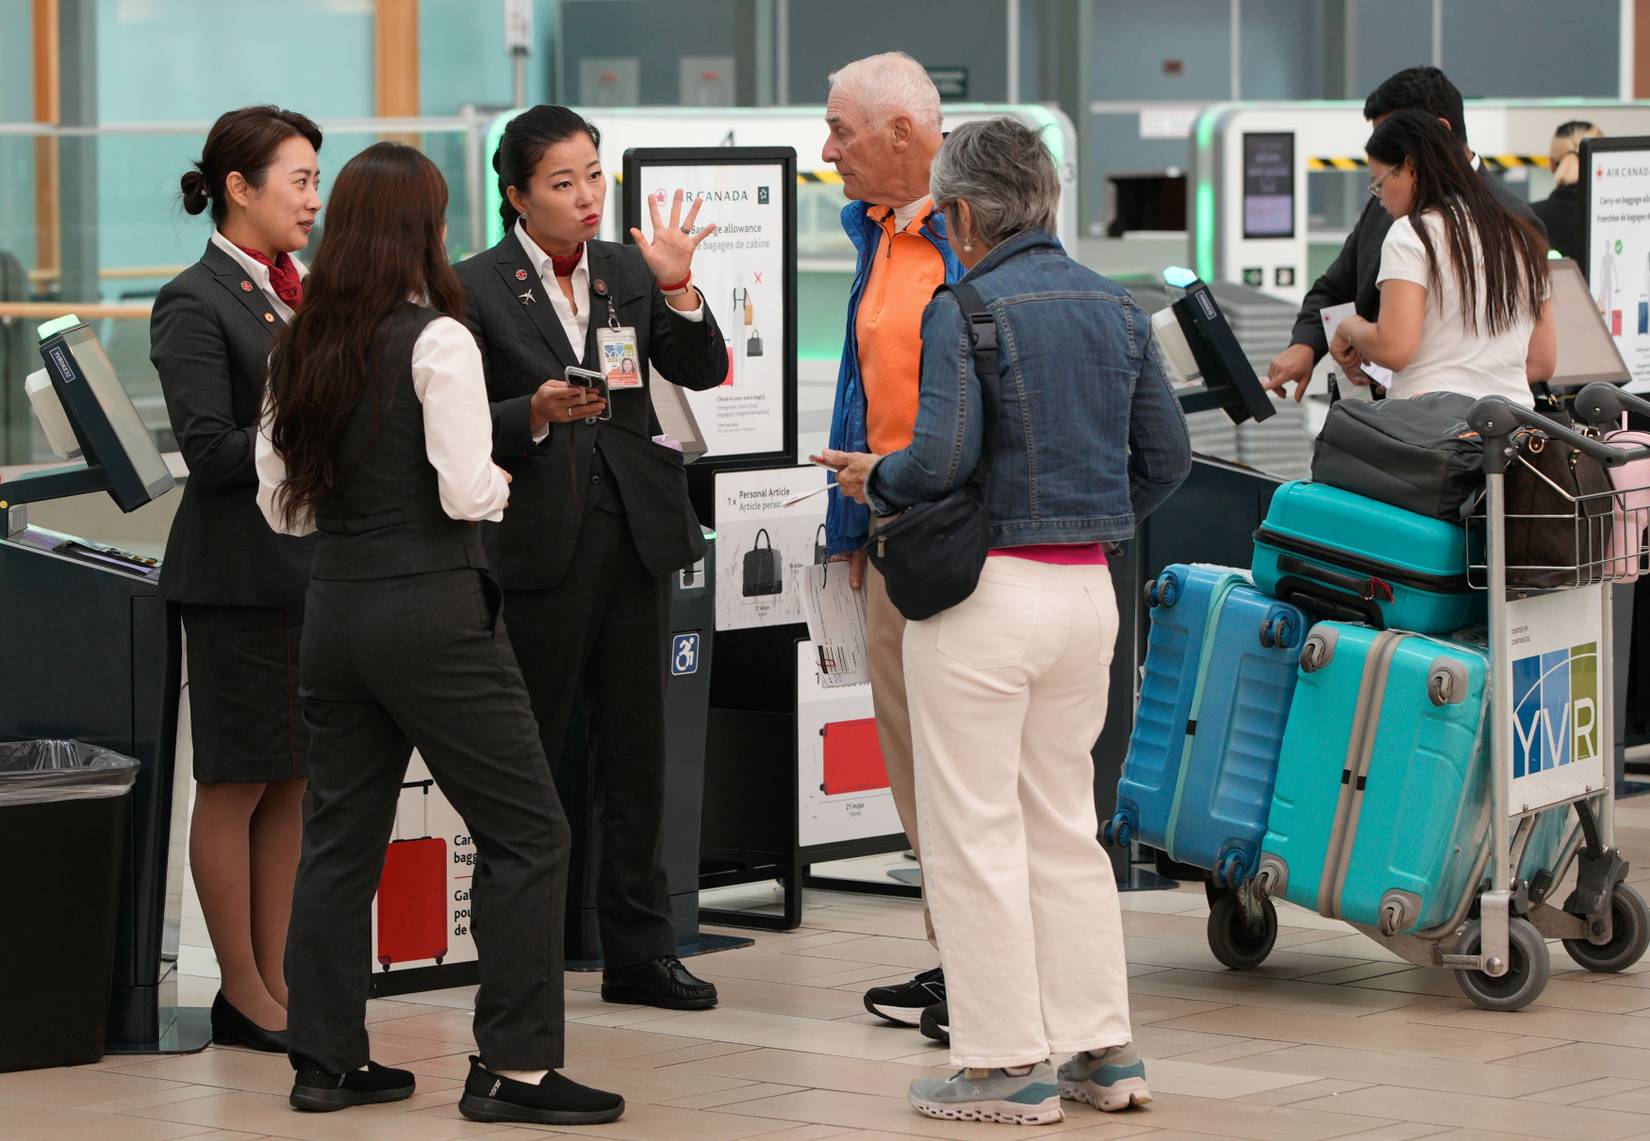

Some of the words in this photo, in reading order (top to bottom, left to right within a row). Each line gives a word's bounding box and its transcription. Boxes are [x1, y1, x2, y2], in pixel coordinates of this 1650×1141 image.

[1621, 167, 1650, 178] CANAD
[724, 223, 762, 234] allowance
[704, 241, 733, 252] bagages
[736, 240, 745, 250] de
[746, 237, 770, 249] cabine
[740, 489, 767, 498] Personal
[769, 487, 790, 496] Article
[740, 501, 761, 511] Article
[763, 501, 784, 511] perso
[1513, 697, 1598, 776] YVR
[454, 924, 467, 936] de
